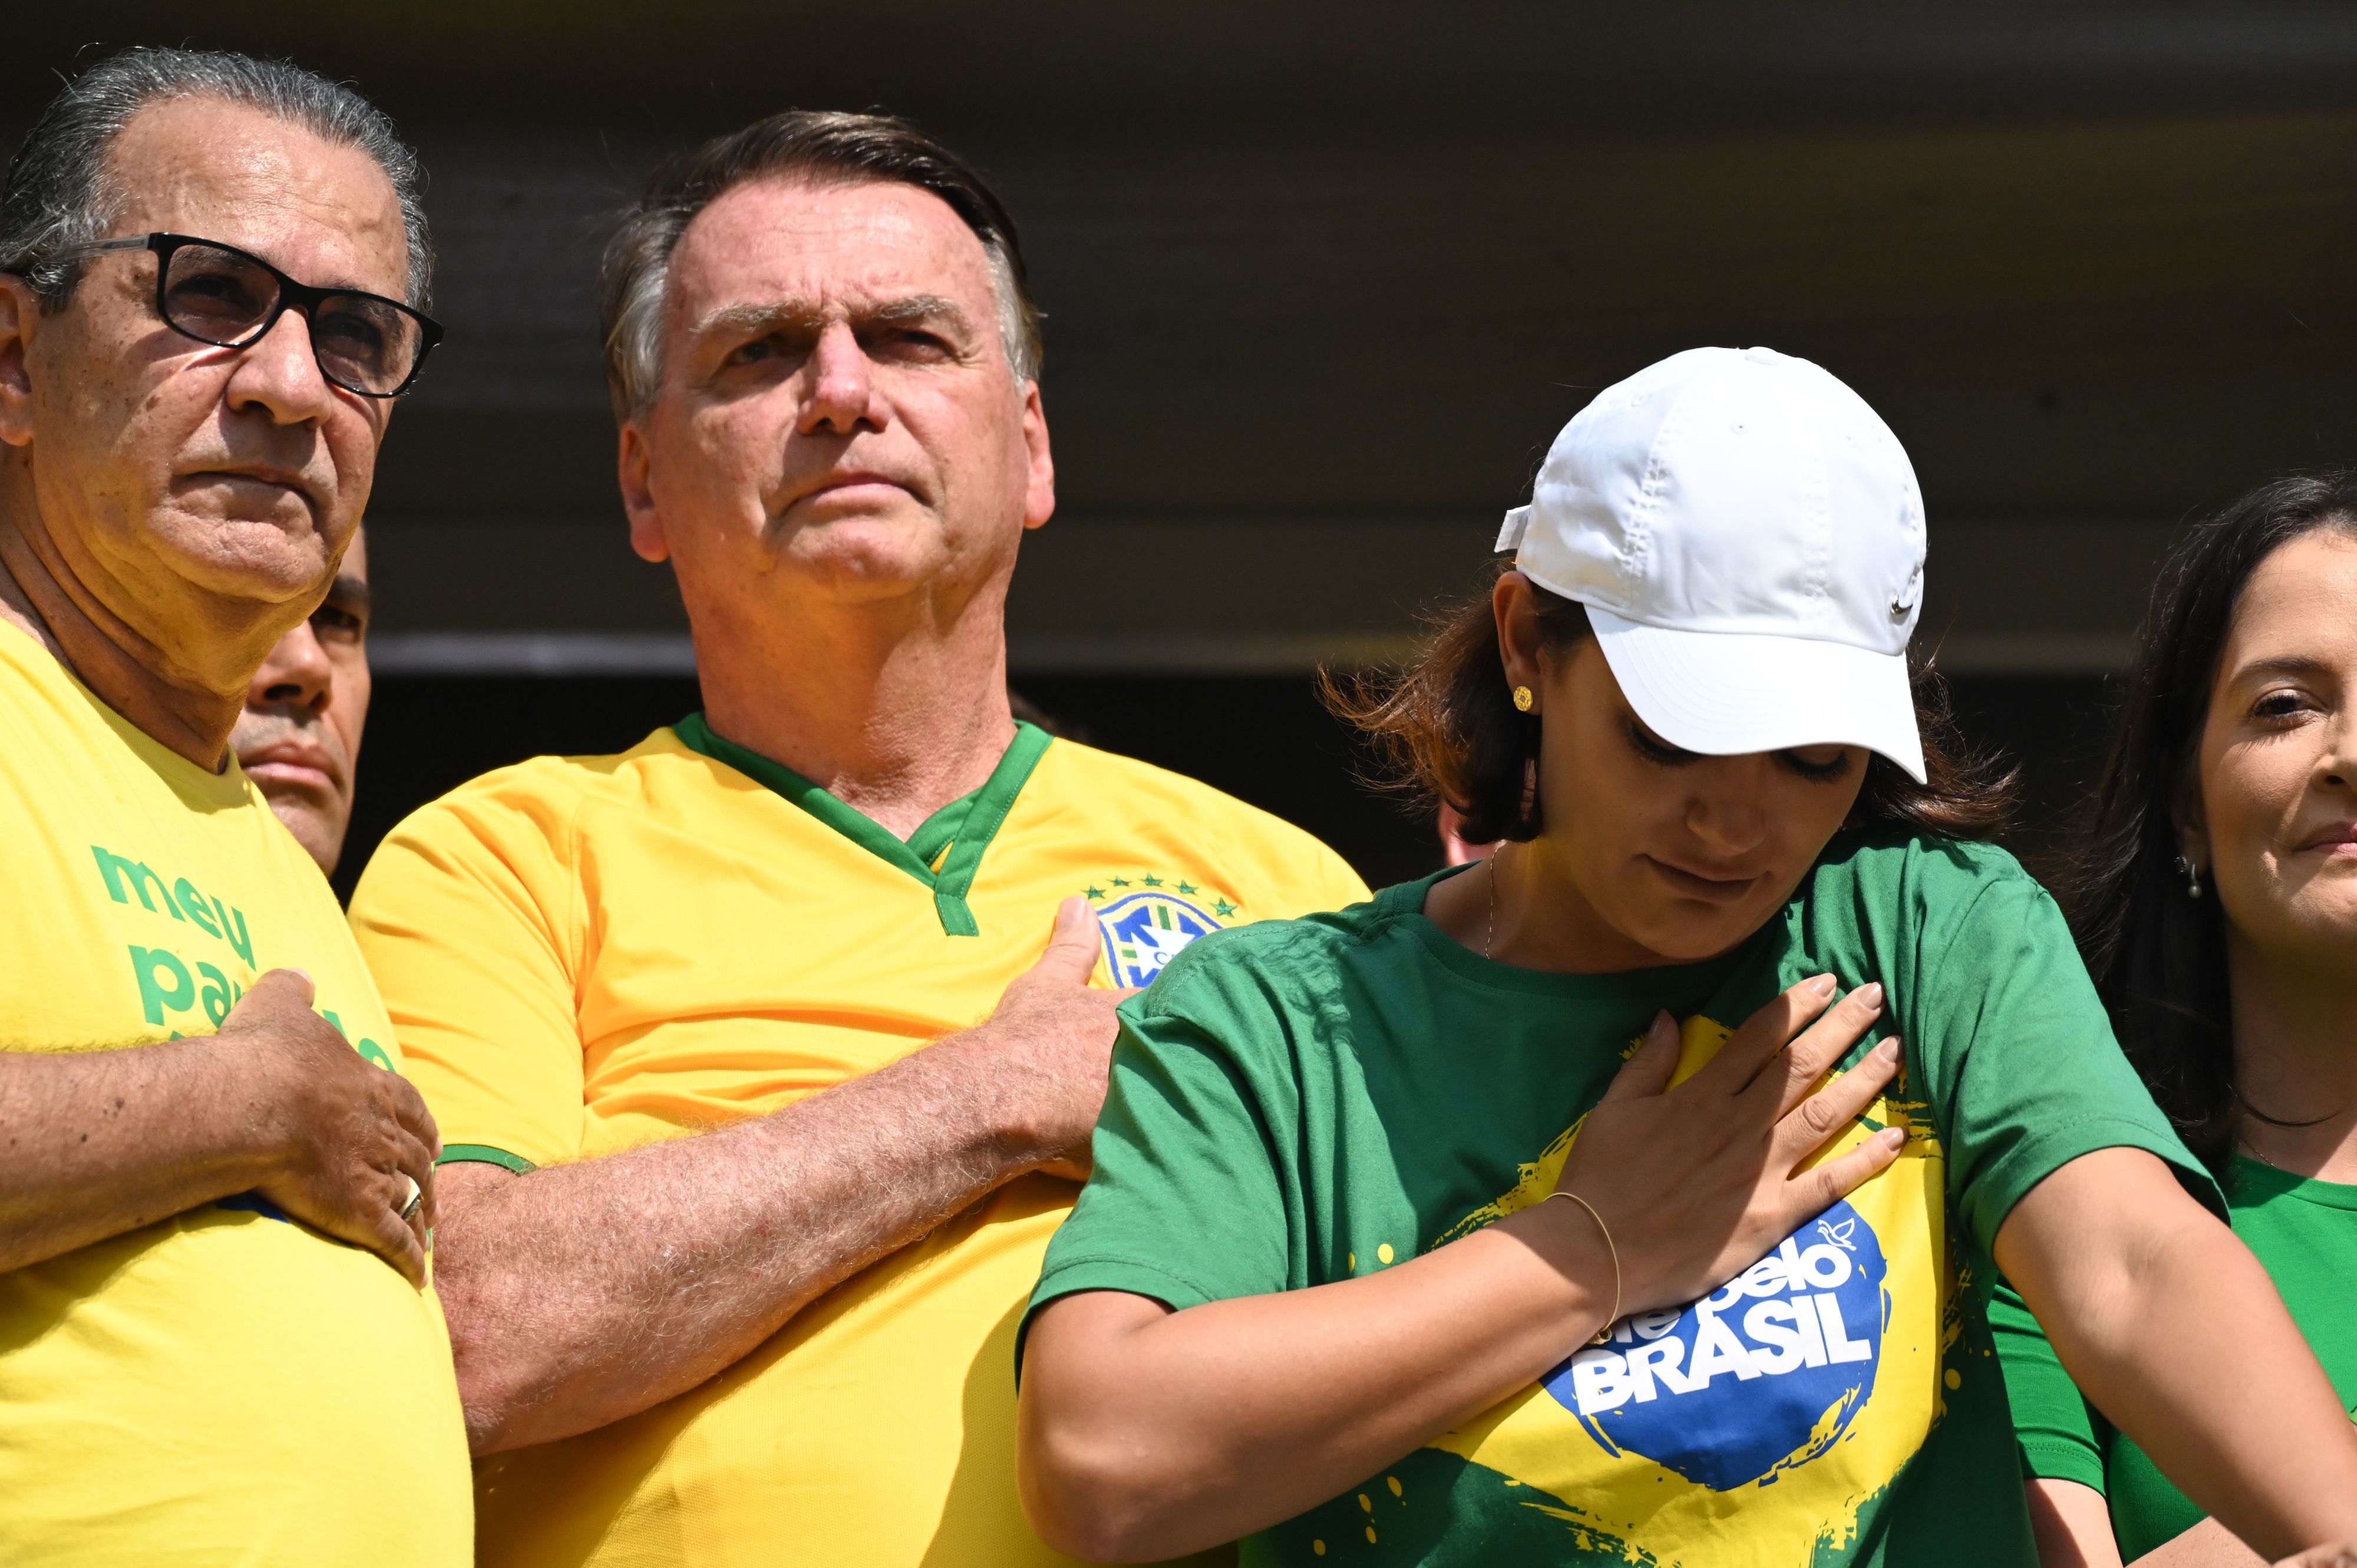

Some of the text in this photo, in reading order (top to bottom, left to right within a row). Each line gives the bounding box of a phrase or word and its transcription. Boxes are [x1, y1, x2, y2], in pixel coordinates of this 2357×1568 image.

[91, 845, 256, 972] meu
[1695, 1236, 1852, 1324] pelo
[1571, 1292, 1872, 1415] BRASIL
